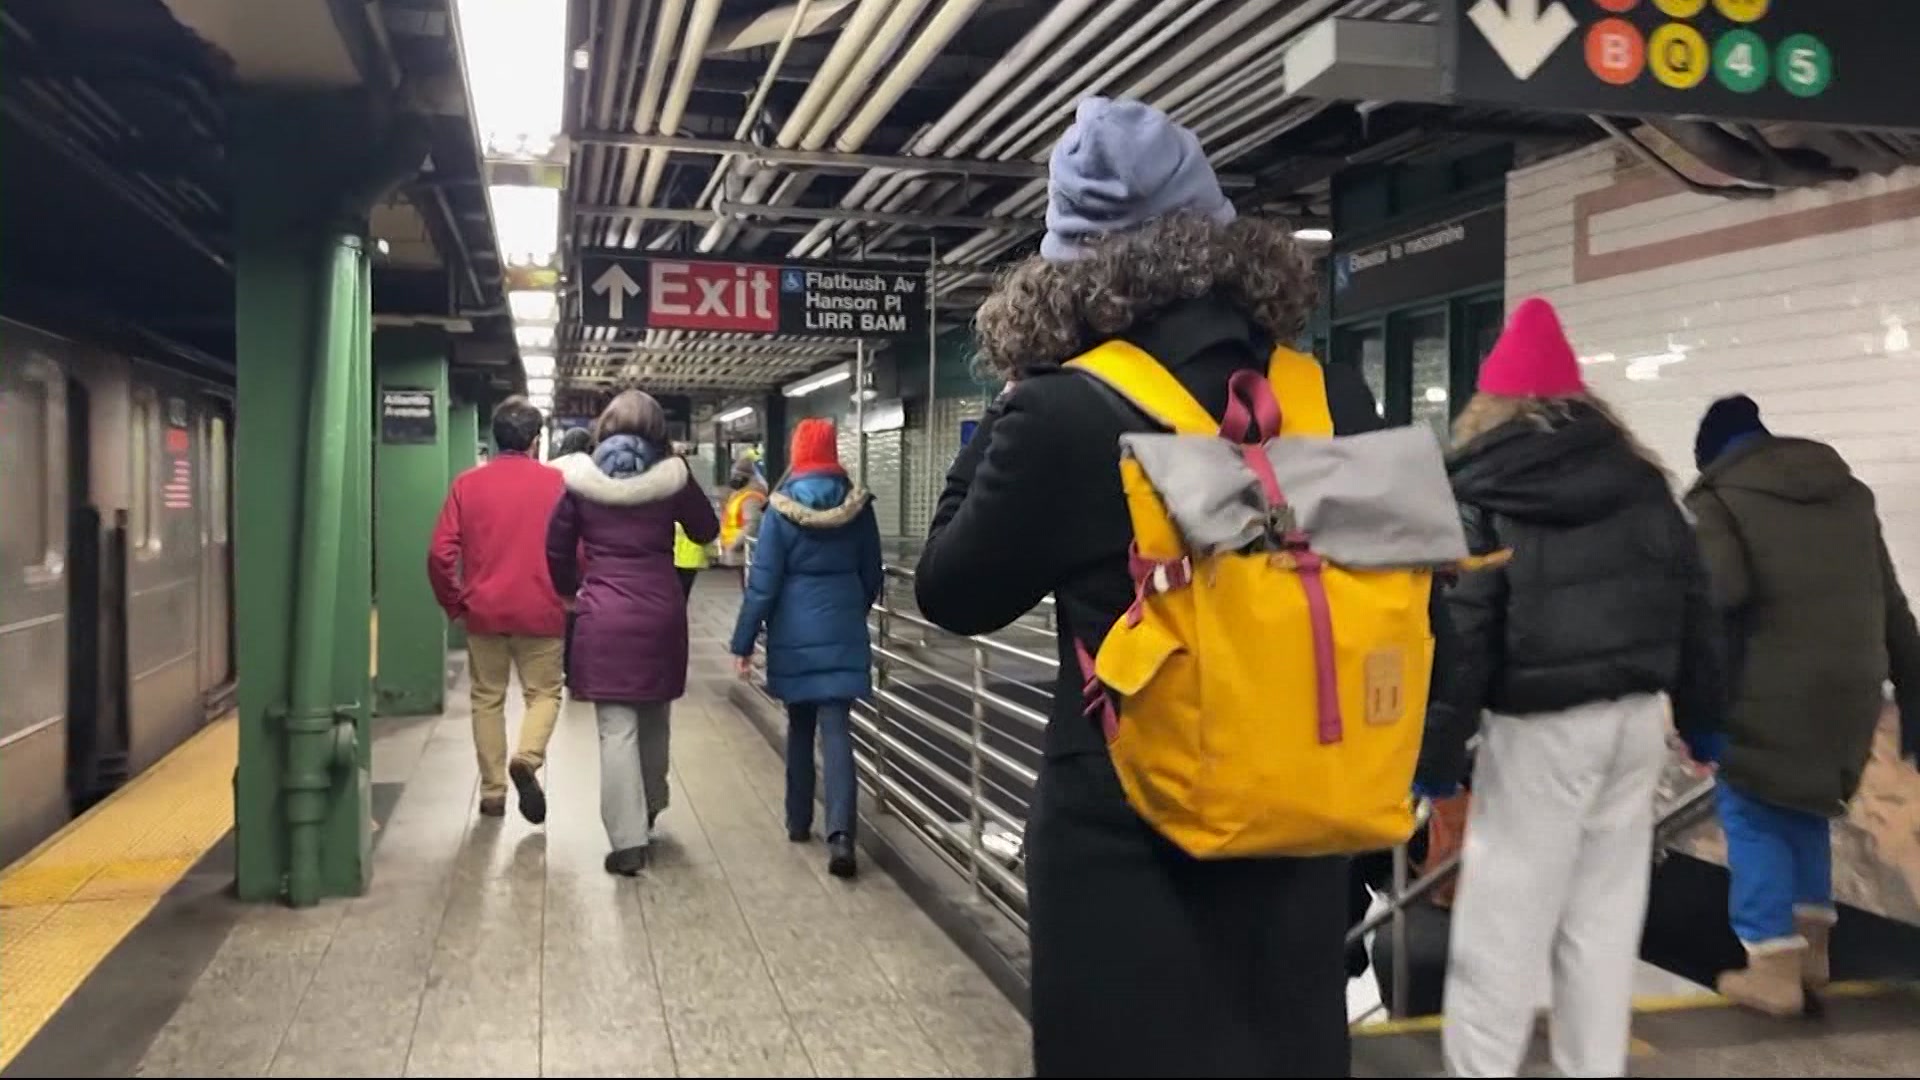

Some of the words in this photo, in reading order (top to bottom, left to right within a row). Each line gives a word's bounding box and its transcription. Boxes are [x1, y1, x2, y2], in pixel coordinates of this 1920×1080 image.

[1601, 33, 1633, 69] B
[1663, 38, 1691, 73] Q
[1725, 42, 1756, 79] 4
[1788, 48, 1819, 86] 5
[651, 262, 772, 318] Exit
[805, 271, 887, 292] Flatbush
[893, 276, 916, 293] Av
[805, 291, 878, 311] Hanson
[884, 294, 902, 312] Pl
[805, 311, 853, 330] LIRR
[860, 314, 906, 331] BAM
